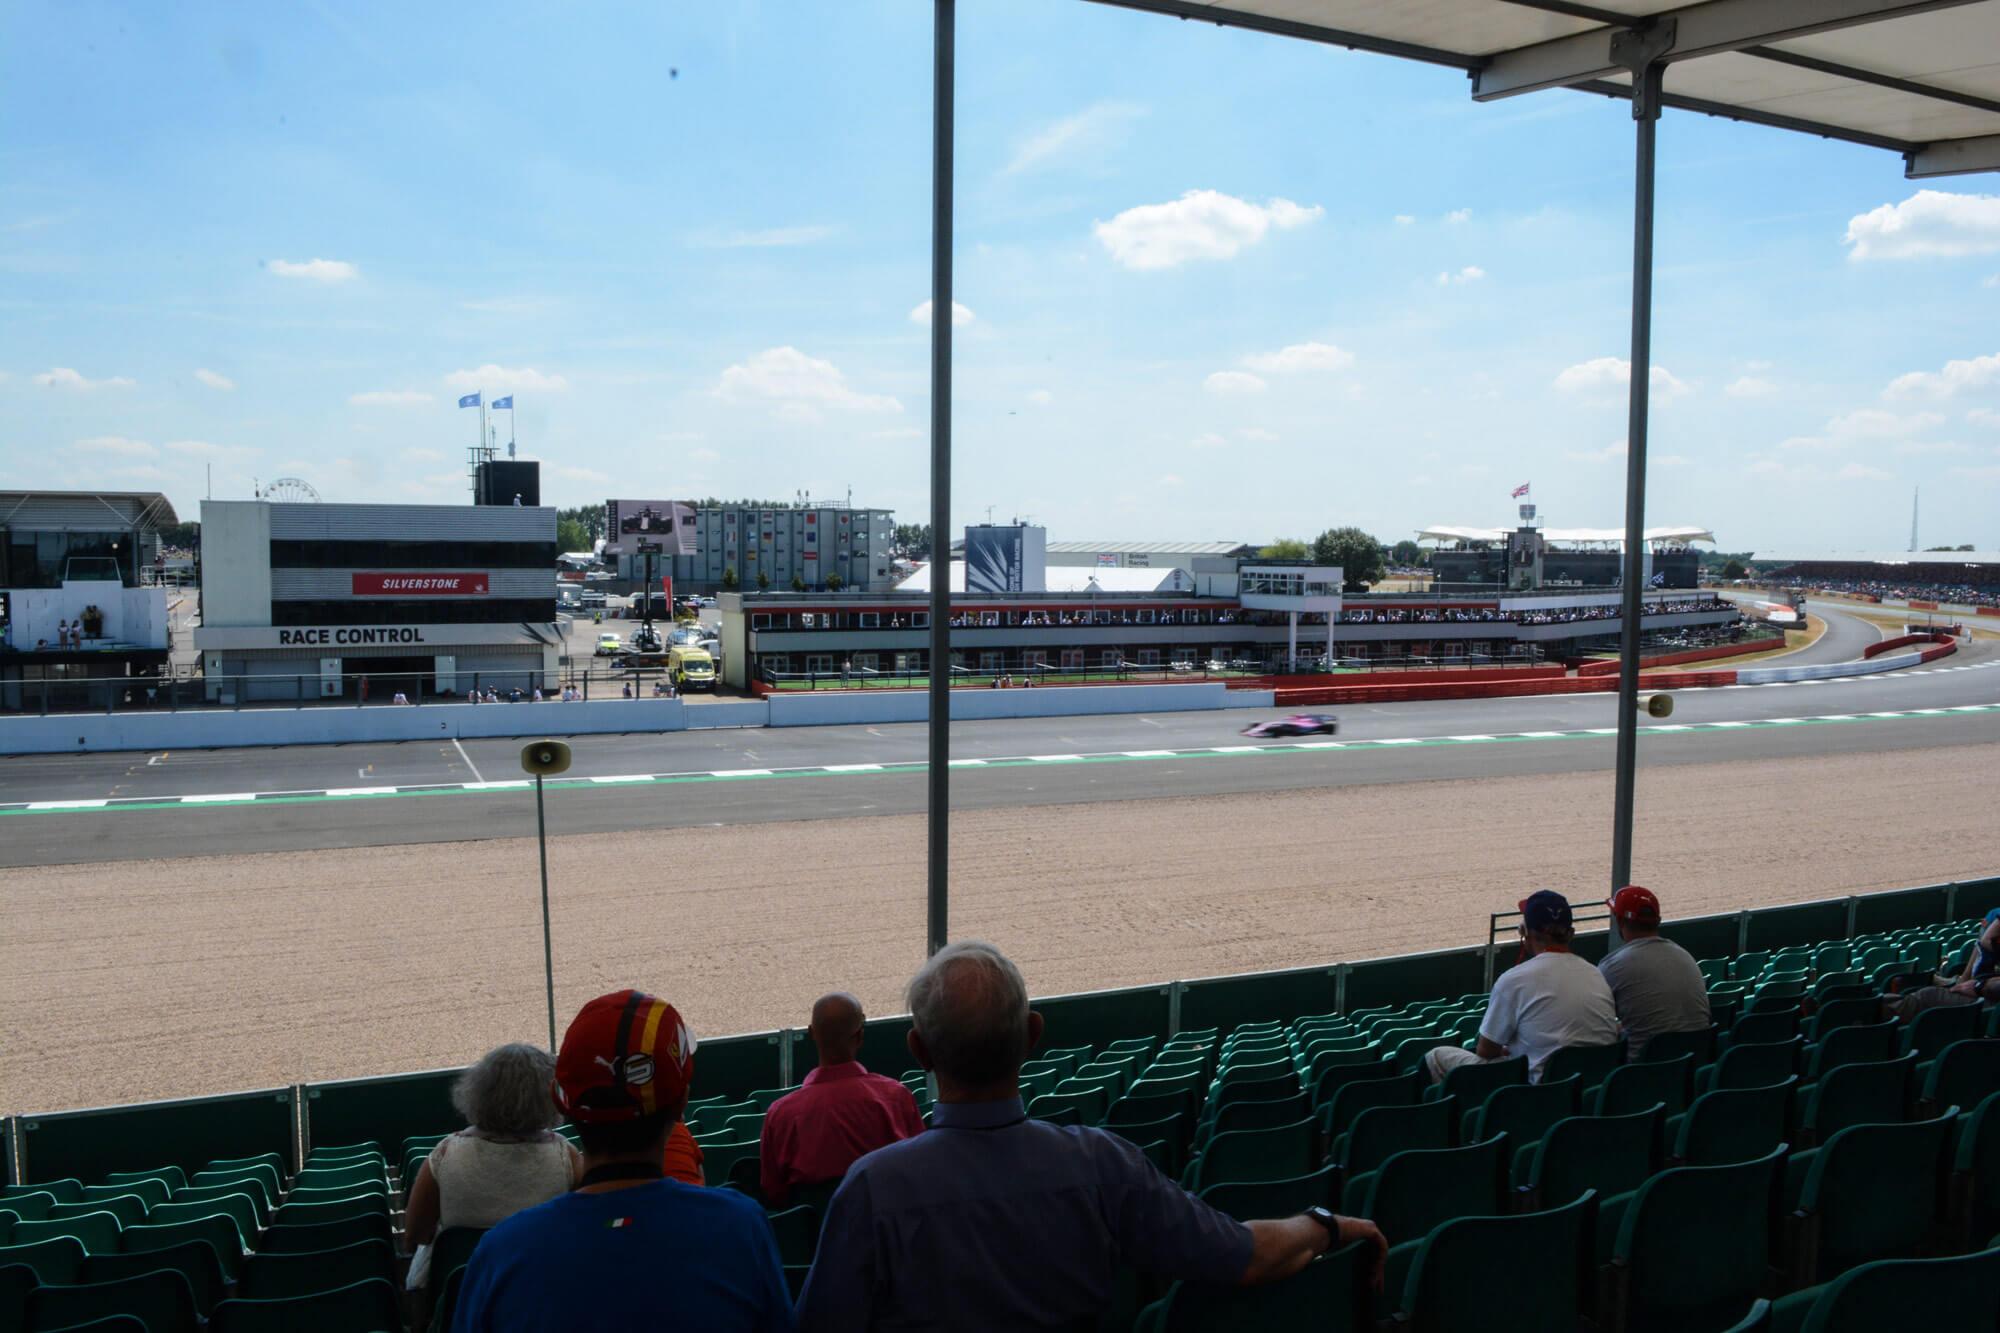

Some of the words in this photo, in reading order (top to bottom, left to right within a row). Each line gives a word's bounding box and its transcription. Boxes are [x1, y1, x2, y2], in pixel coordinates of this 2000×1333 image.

[382, 578, 460, 589] SILVERSTONE
[279, 630, 329, 645] RACE
[335, 628, 424, 644] CONTROL
